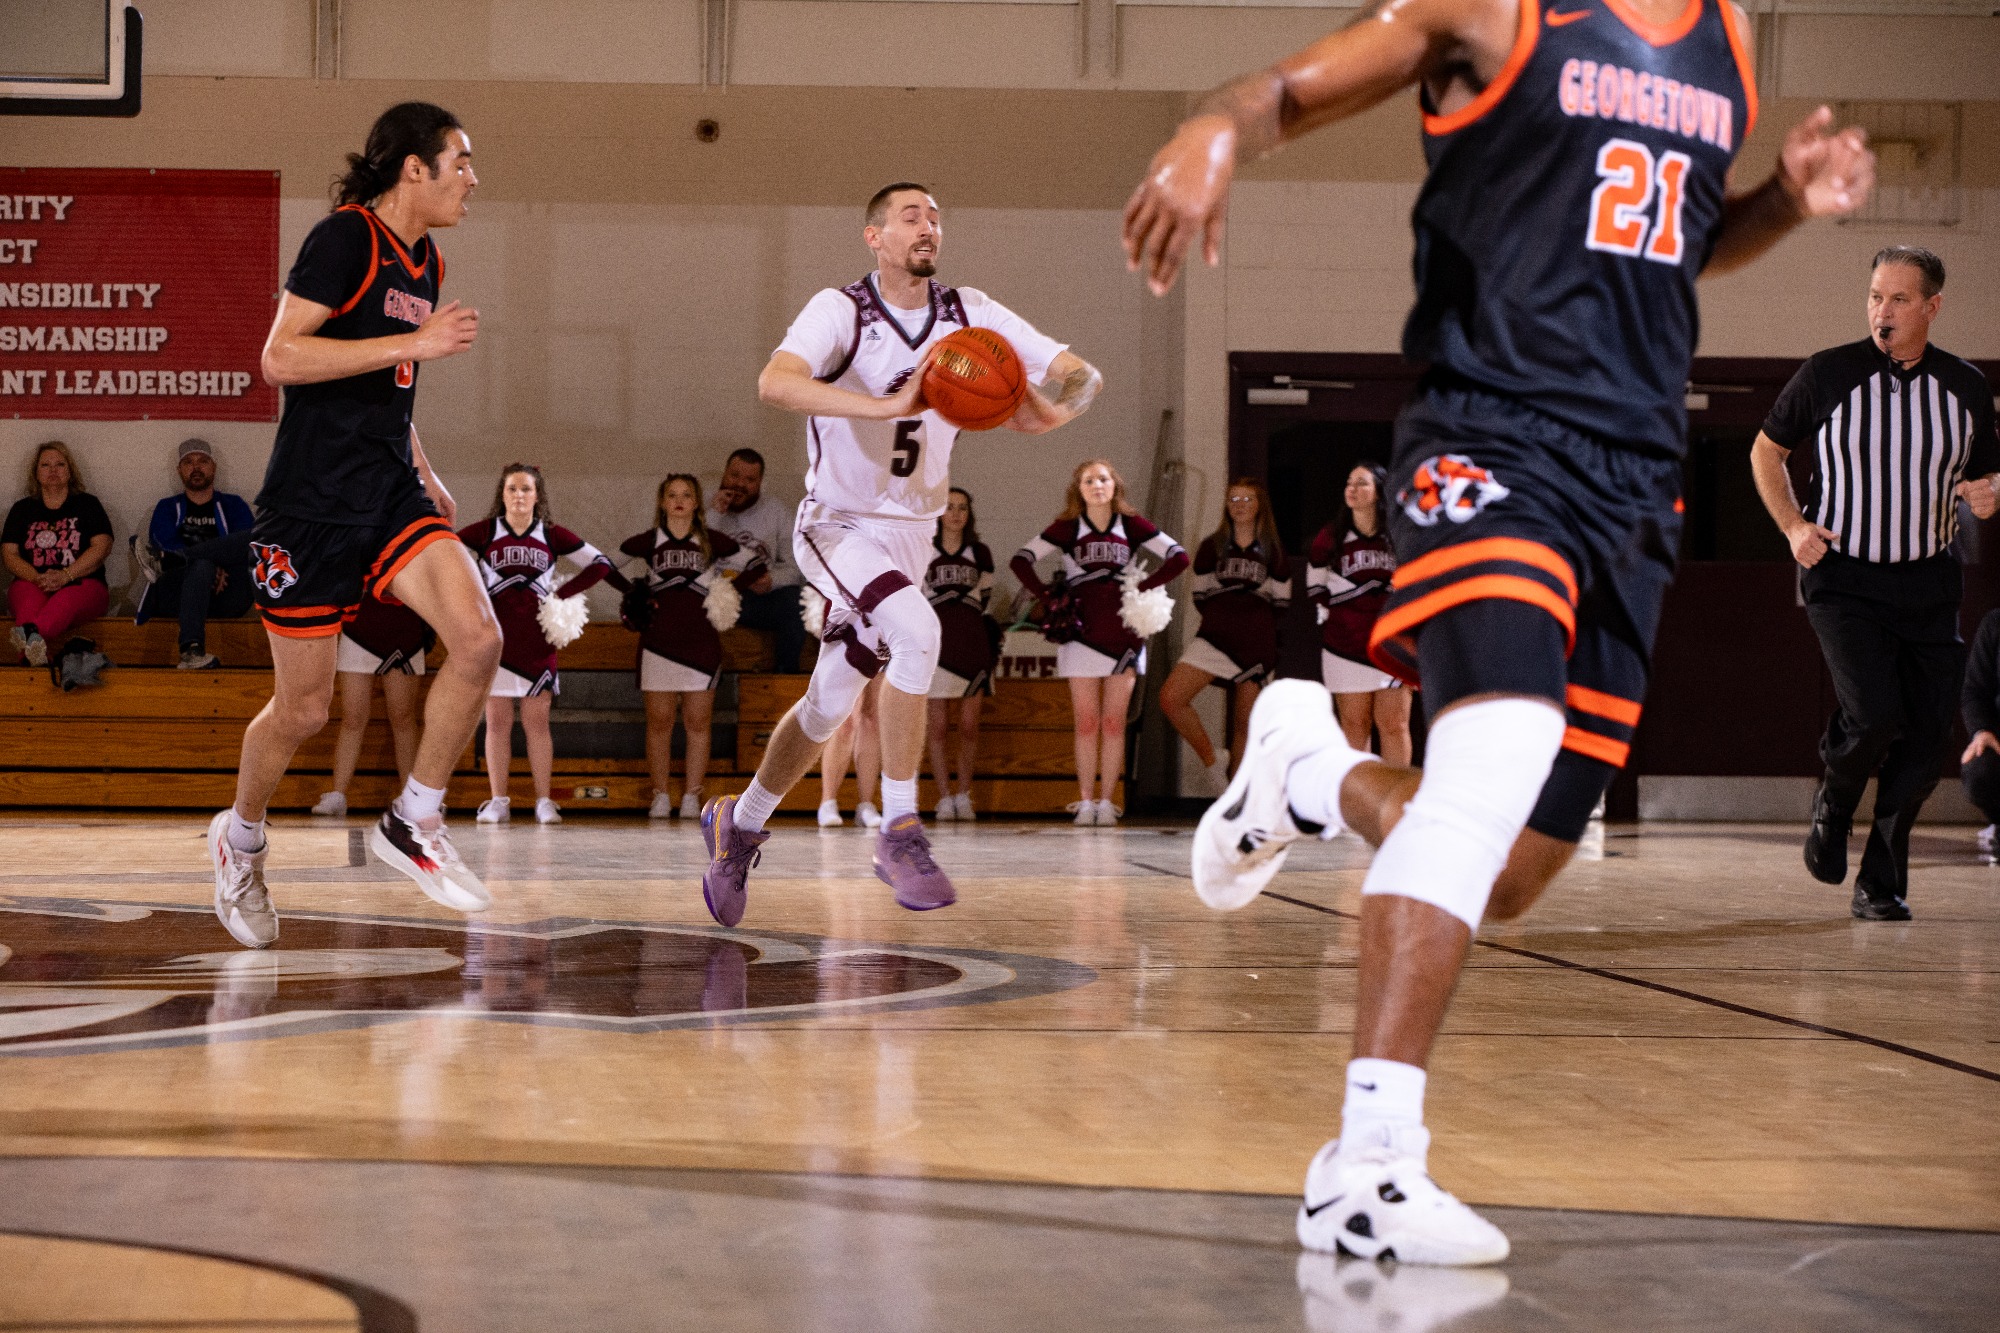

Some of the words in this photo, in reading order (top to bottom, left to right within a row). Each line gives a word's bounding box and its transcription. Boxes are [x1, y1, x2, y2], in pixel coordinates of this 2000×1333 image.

[1558, 57, 1733, 152] GEORGETOWN
[0, 195, 74, 220] RITY
[1585, 137, 1691, 266] 21
[0, 238, 38, 264] CT
[0, 283, 161, 308] NSIBILITY
[0, 326, 168, 351] SMANSHIP
[0, 370, 47, 395] NT
[55, 370, 251, 396] LEADERSHIP
[890, 420, 923, 478] 5
[490, 545, 549, 571] LIONS
[1074, 541, 1130, 566] LIONS
